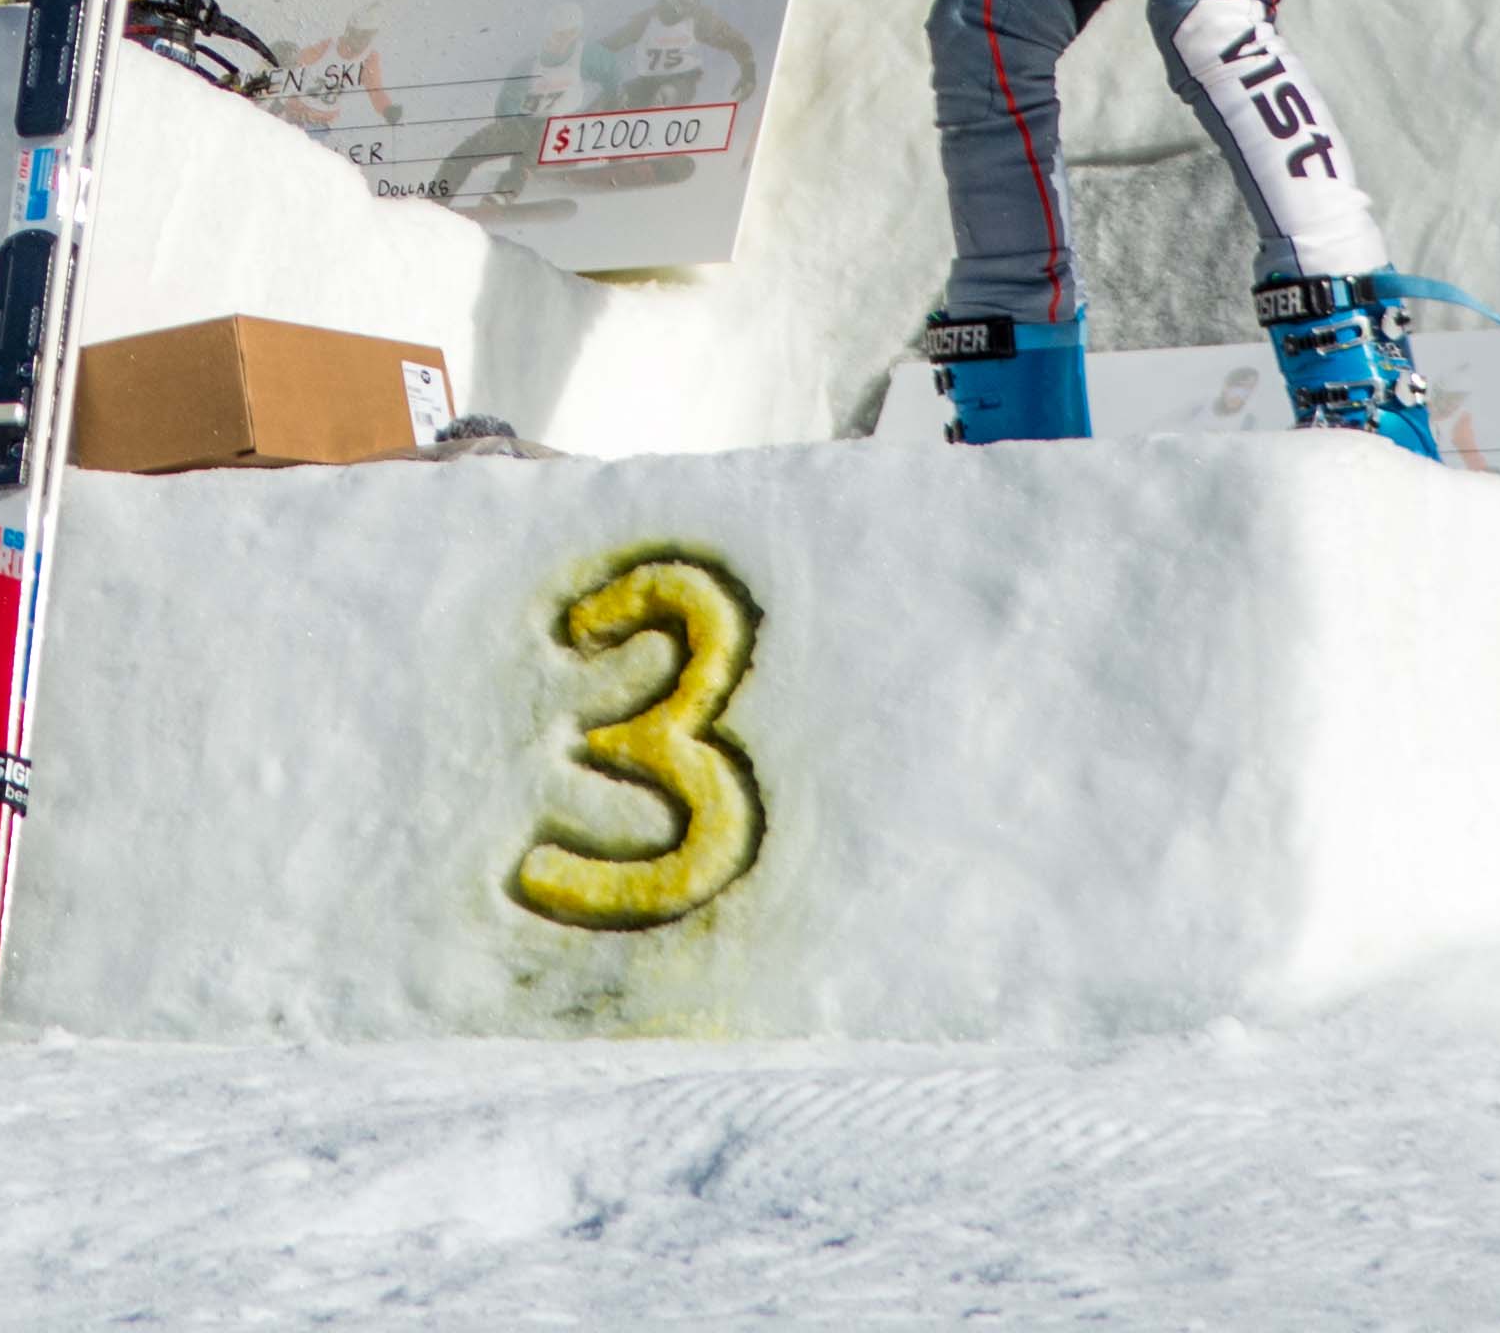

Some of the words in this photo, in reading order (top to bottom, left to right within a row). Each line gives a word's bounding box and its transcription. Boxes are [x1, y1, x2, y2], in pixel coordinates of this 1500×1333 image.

[647, 47, 685, 71] 75
[323, 60, 366, 90] SKI
[376, 179, 451, 199] DOLLARS
[506, 541, 769, 931] 3
